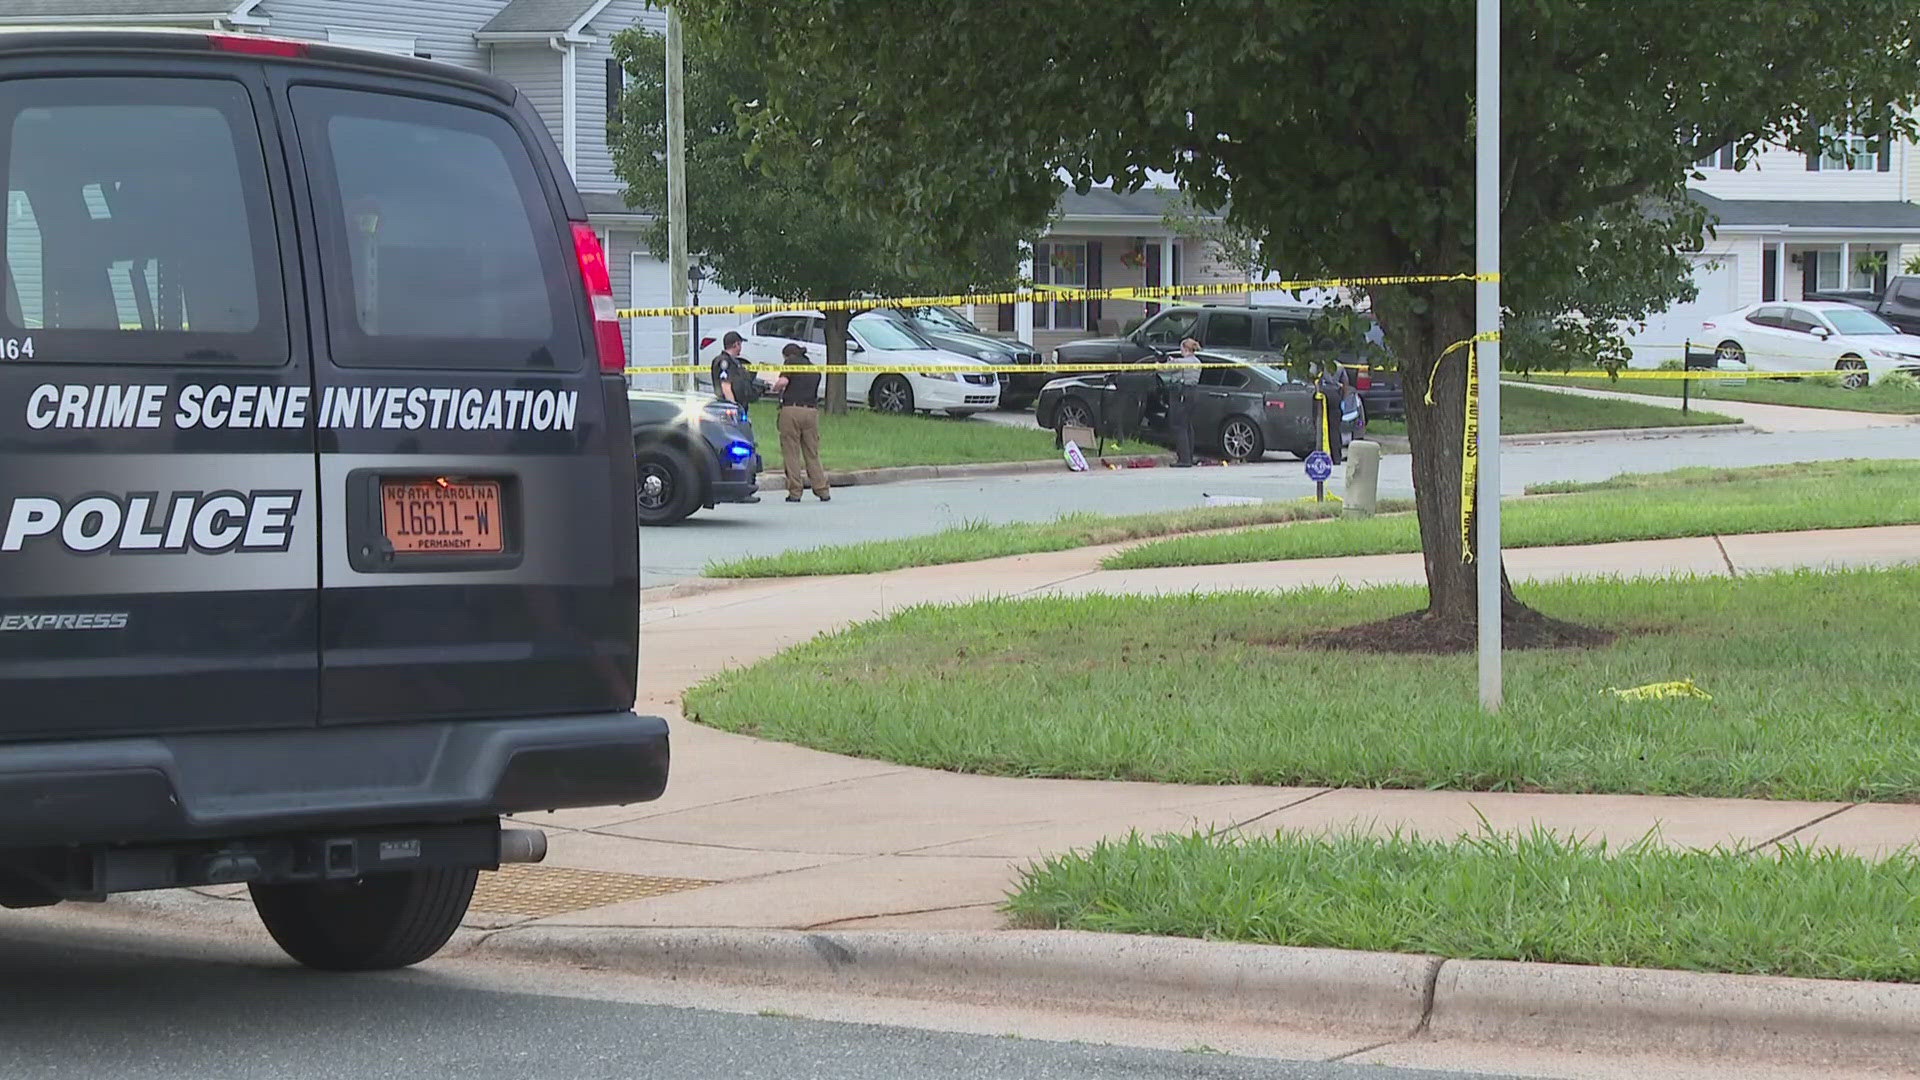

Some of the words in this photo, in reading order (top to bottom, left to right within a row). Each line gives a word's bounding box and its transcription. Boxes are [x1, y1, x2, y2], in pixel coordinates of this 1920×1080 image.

[960, 293, 1000, 305] POLICIA
[1006, 291, 1038, 304] LINEA
[1042, 290, 1056, 303] NO
[1061, 289, 1074, 302] SE
[1078, 288, 1113, 301] CRUCE
[1132, 286, 1170, 298] POLICE
[1174, 285, 1199, 297] LINE
[1203, 284, 1217, 295] DO
[1221, 283, 1243, 294] NOT
[1247, 281, 1282, 292] CROSS
[26, 384, 167, 430] CRIME
[175, 385, 312, 430] SCENE
[318, 387, 578, 431] INVESTIGATION
[1467, 425, 1478, 457] CROSS
[387, 487, 430, 500] NORTH
[435, 487, 494, 500] CAROLINA
[1, 494, 297, 553] POLICE
[395, 501, 489, 536] 16611-W
[418, 539, 471, 548] PERMANENT
[0, 613, 129, 631] EXPRESS
